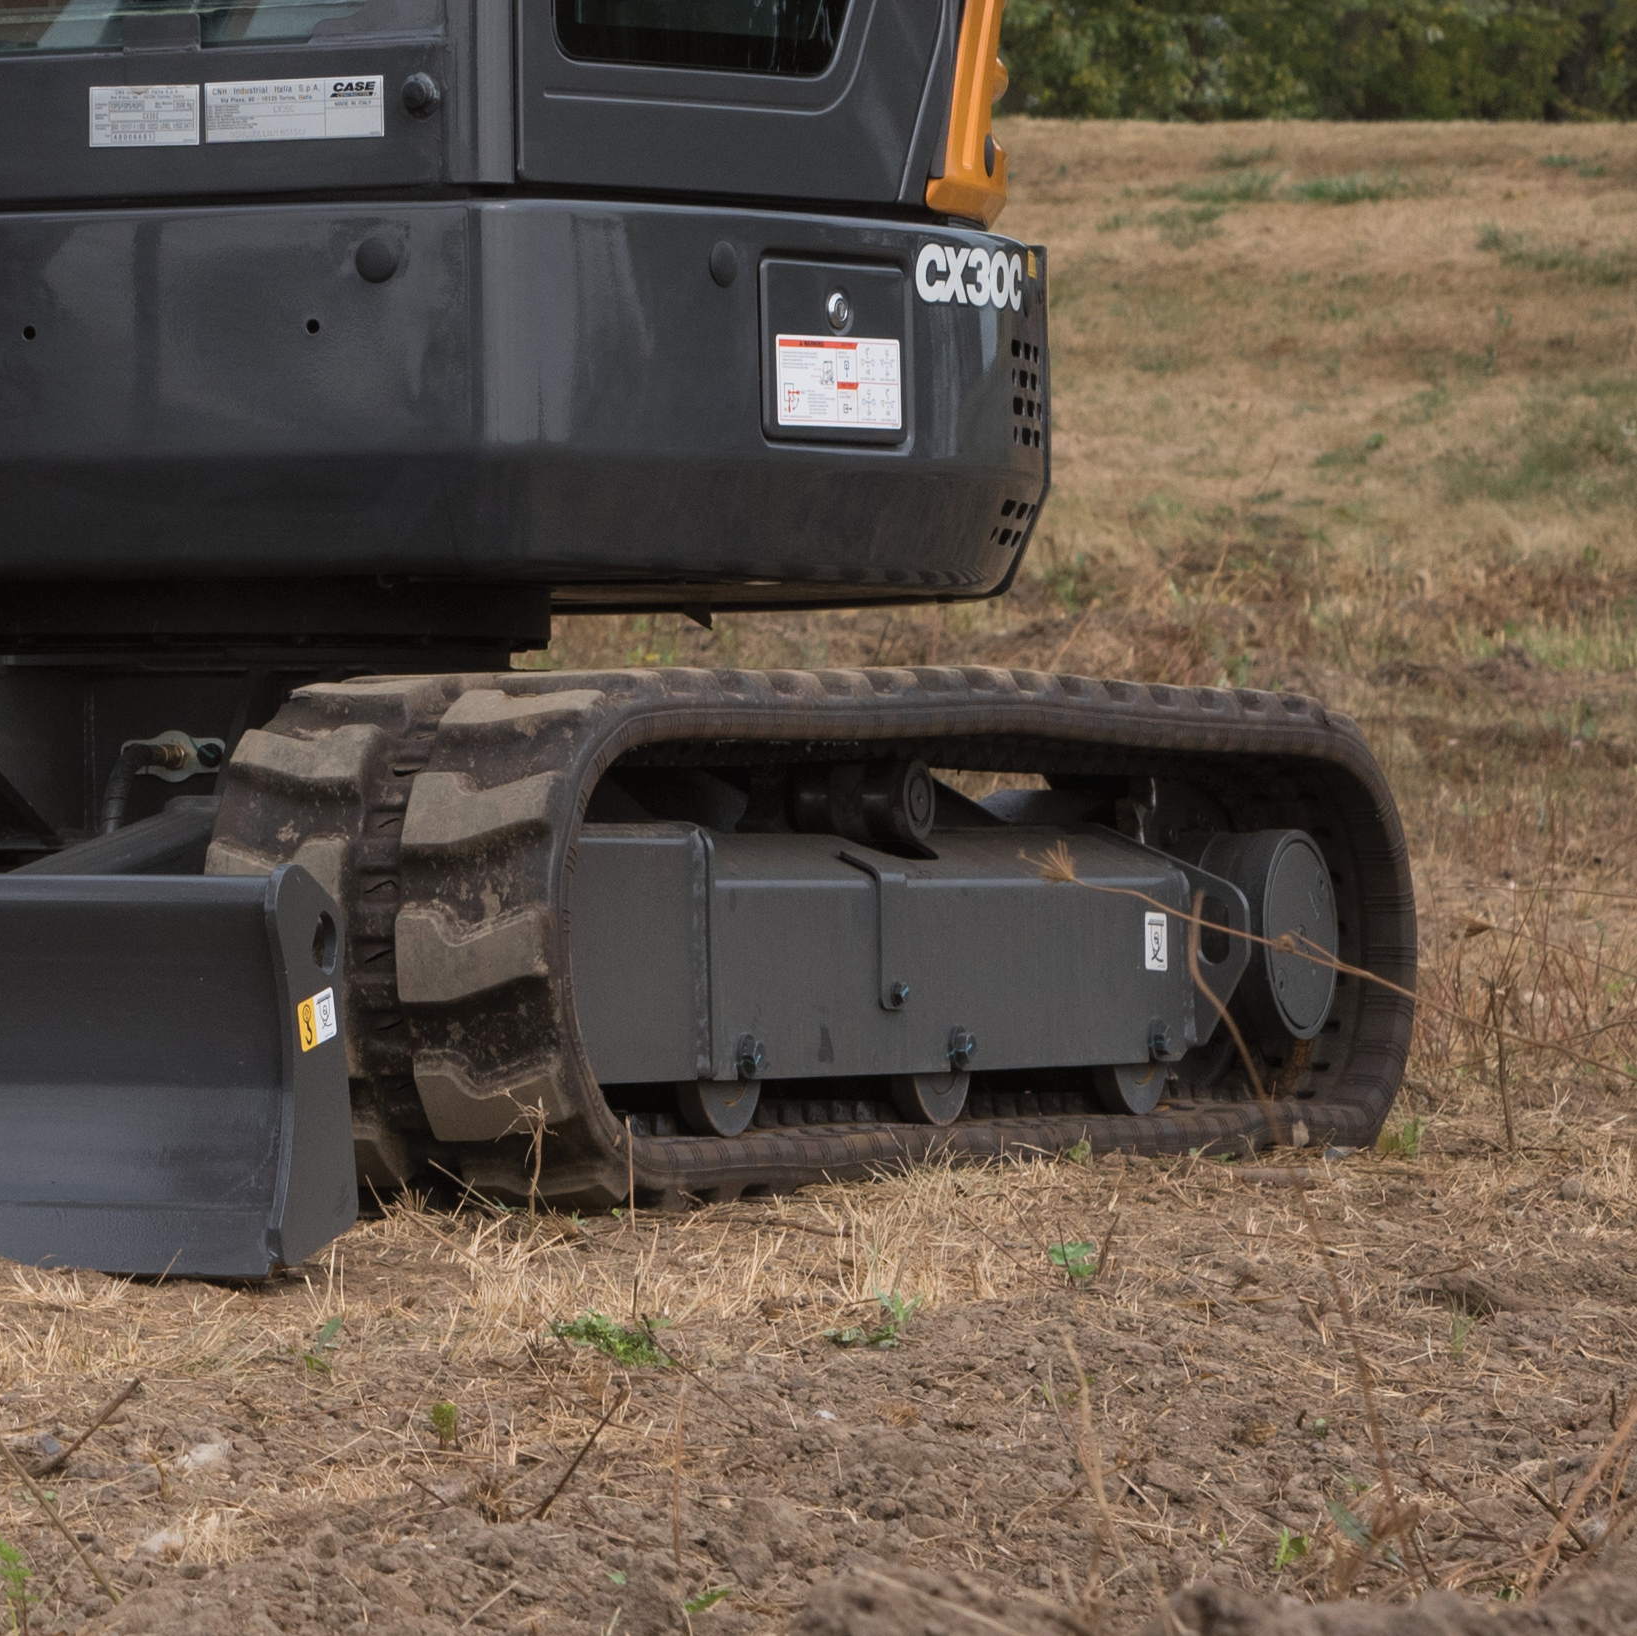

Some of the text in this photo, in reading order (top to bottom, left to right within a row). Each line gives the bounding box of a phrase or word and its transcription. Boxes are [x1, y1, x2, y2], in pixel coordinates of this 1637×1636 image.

[212, 88, 228, 96] CNH
[233, 86, 268, 95] Industrial
[274, 85, 293, 93] Italia
[333, 81, 376, 92] CASE
[915, 242, 1022, 312] CX30C
